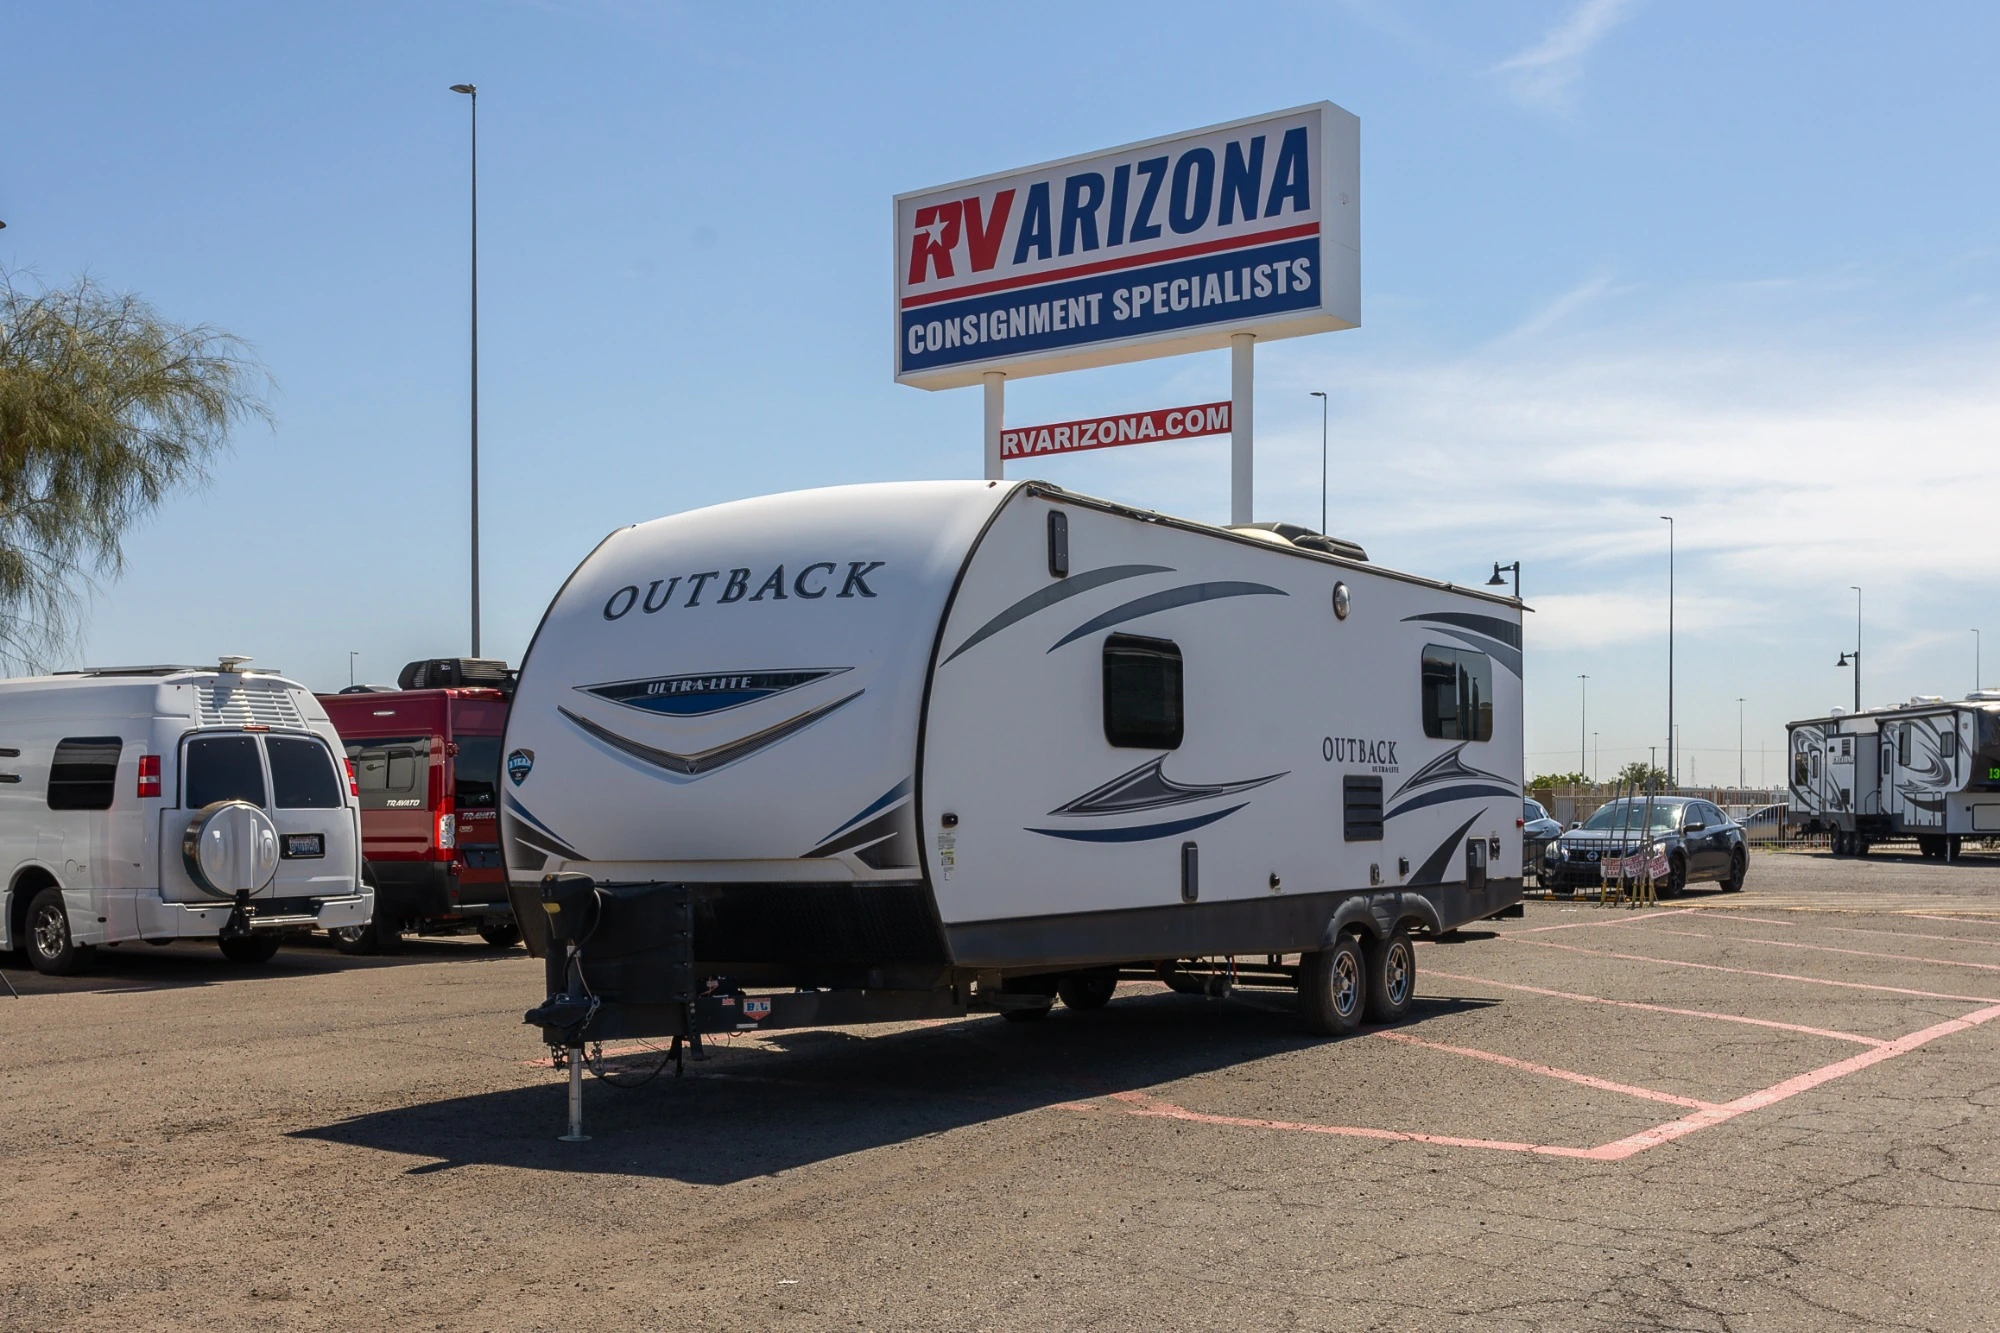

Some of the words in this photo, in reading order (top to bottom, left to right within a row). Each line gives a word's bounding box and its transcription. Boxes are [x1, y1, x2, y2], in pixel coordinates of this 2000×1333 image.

[908, 292, 1102, 354] CONSIGNMENT
[1113, 257, 1311, 320] SPECIALISTS
[1002, 406, 1229, 456] RVARIZONA.COM
[603, 561, 886, 621] OUTBACK
[647, 676, 752, 695] ULTRA-LITE
[1323, 736, 1399, 765] OUTBACK
[1372, 765, 1400, 773] ULTRA-LITE
[386, 799, 421, 807] TRAVATO
